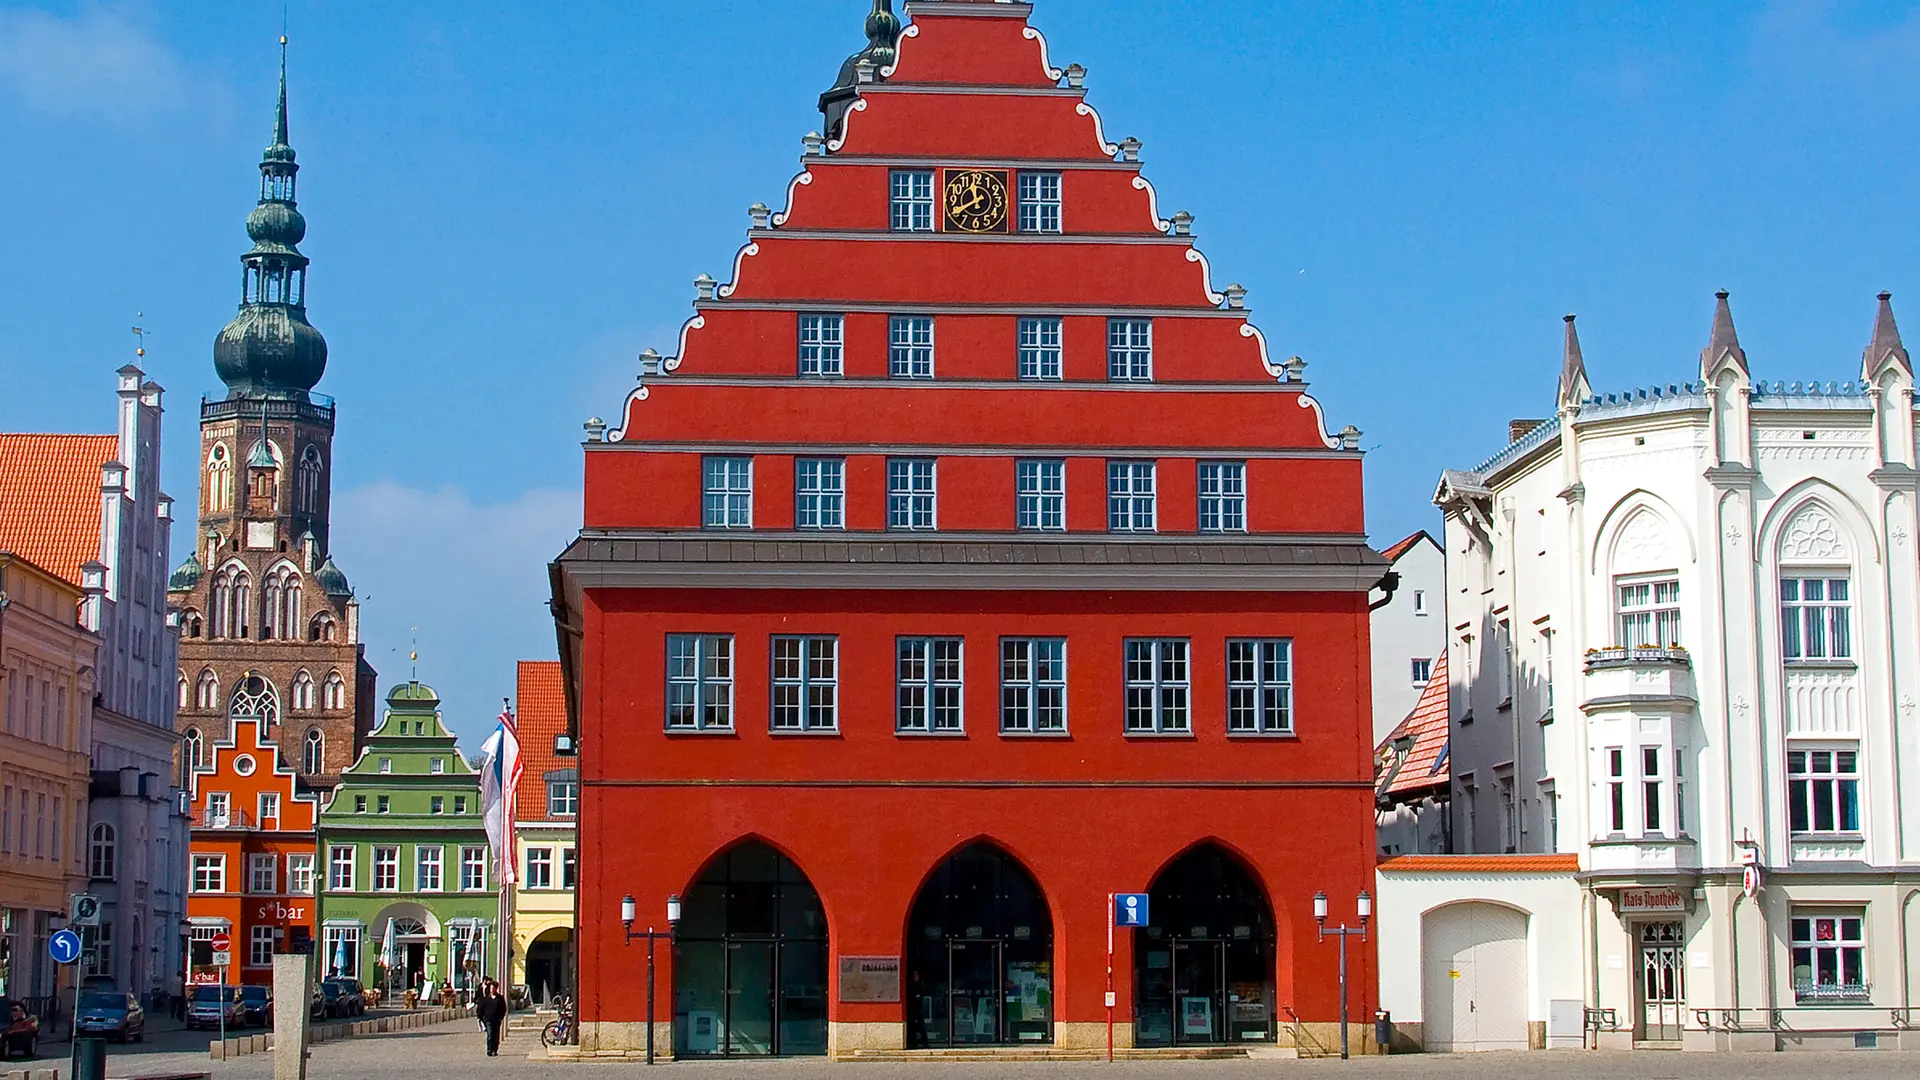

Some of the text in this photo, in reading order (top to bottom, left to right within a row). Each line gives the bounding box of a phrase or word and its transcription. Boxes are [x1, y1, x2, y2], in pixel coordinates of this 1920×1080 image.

[960, 176, 969, 188] 11
[971, 173, 982, 185] 12
[985, 176, 990, 189] 1
[949, 183, 962, 195] 10
[991, 184, 1000, 196] 2
[950, 195, 957, 206] 9
[994, 196, 1002, 208] 3
[990, 207, 998, 219] 4
[960, 214, 968, 226] 7
[972, 217, 980, 229] 6
[983, 214, 991, 227] 5
